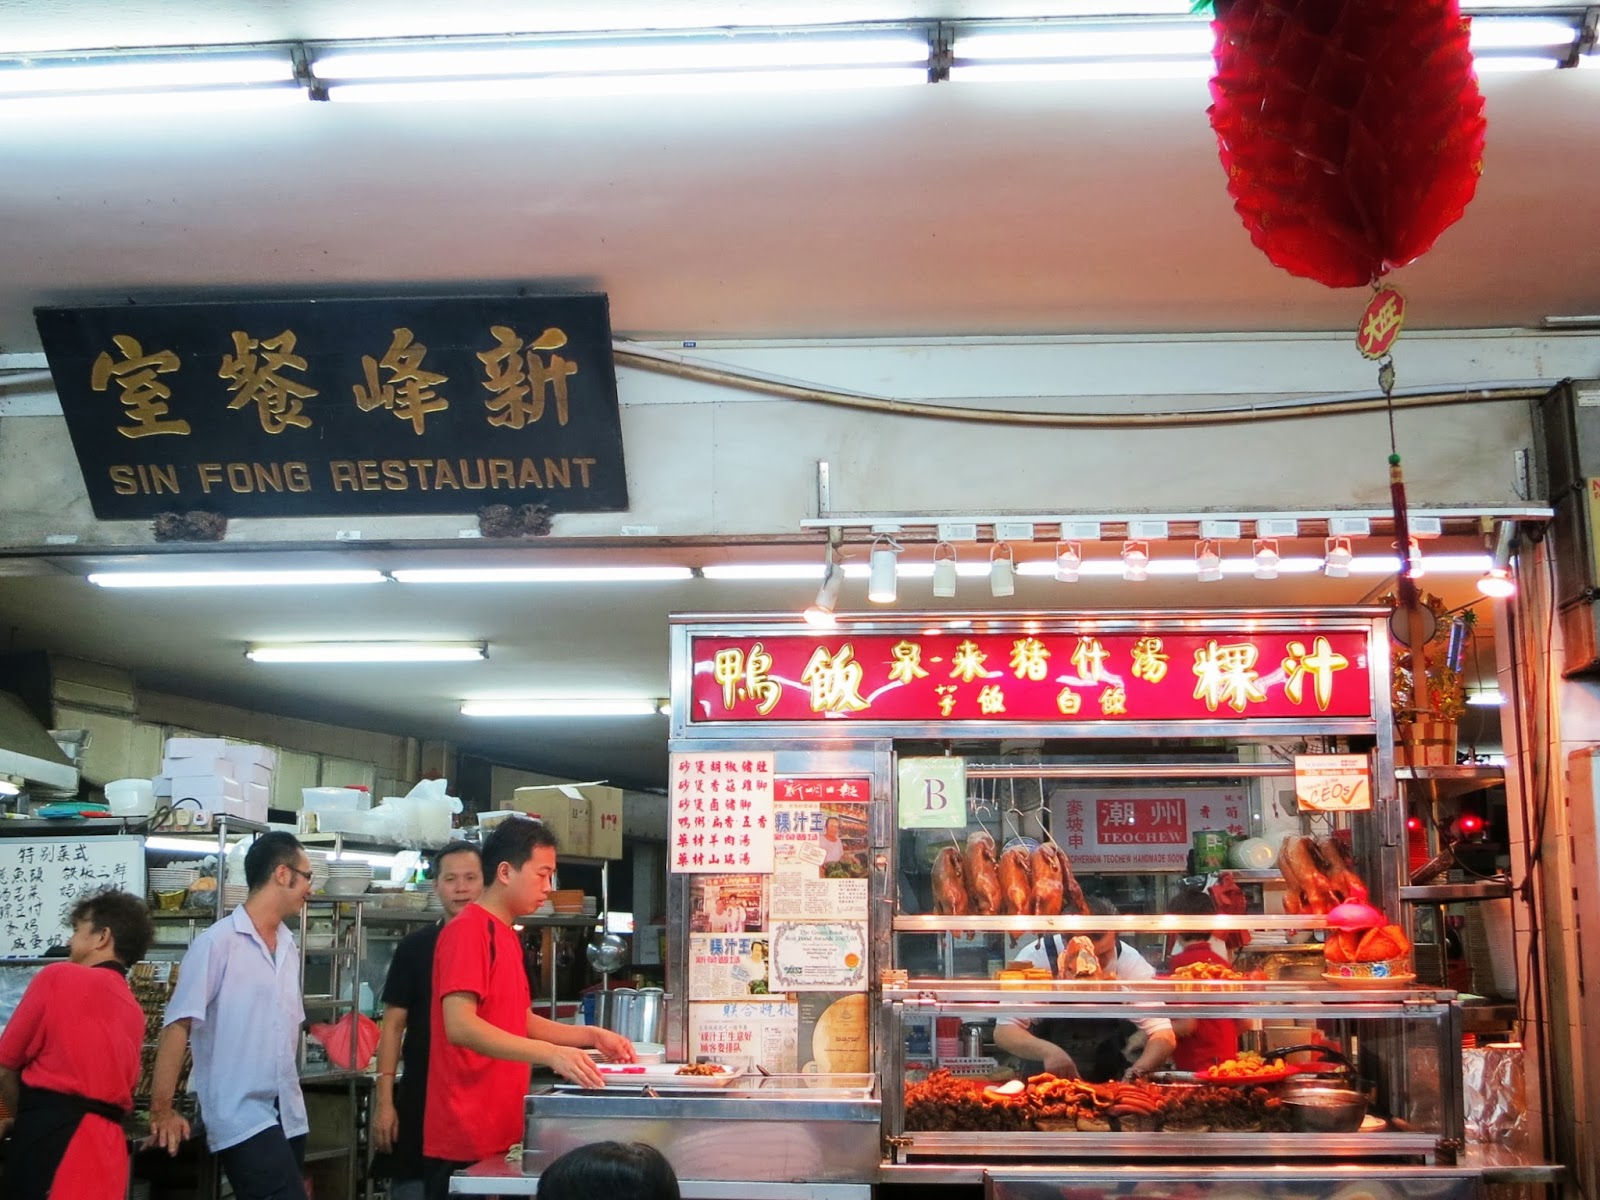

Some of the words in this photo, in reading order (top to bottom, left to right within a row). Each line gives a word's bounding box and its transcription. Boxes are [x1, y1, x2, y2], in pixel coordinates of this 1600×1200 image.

[109, 464, 181, 496] SIN
[200, 462, 312, 494] FONG
[330, 458, 597, 493] RESTAURANT
[924, 779, 948, 810] B
[1102, 831, 1183, 843] TEOCHEW
[1103, 855, 1131, 864] TEOCHEW
[1133, 854, 1166, 863] HANDMADE
[1167, 853, 1185, 862] SOON
